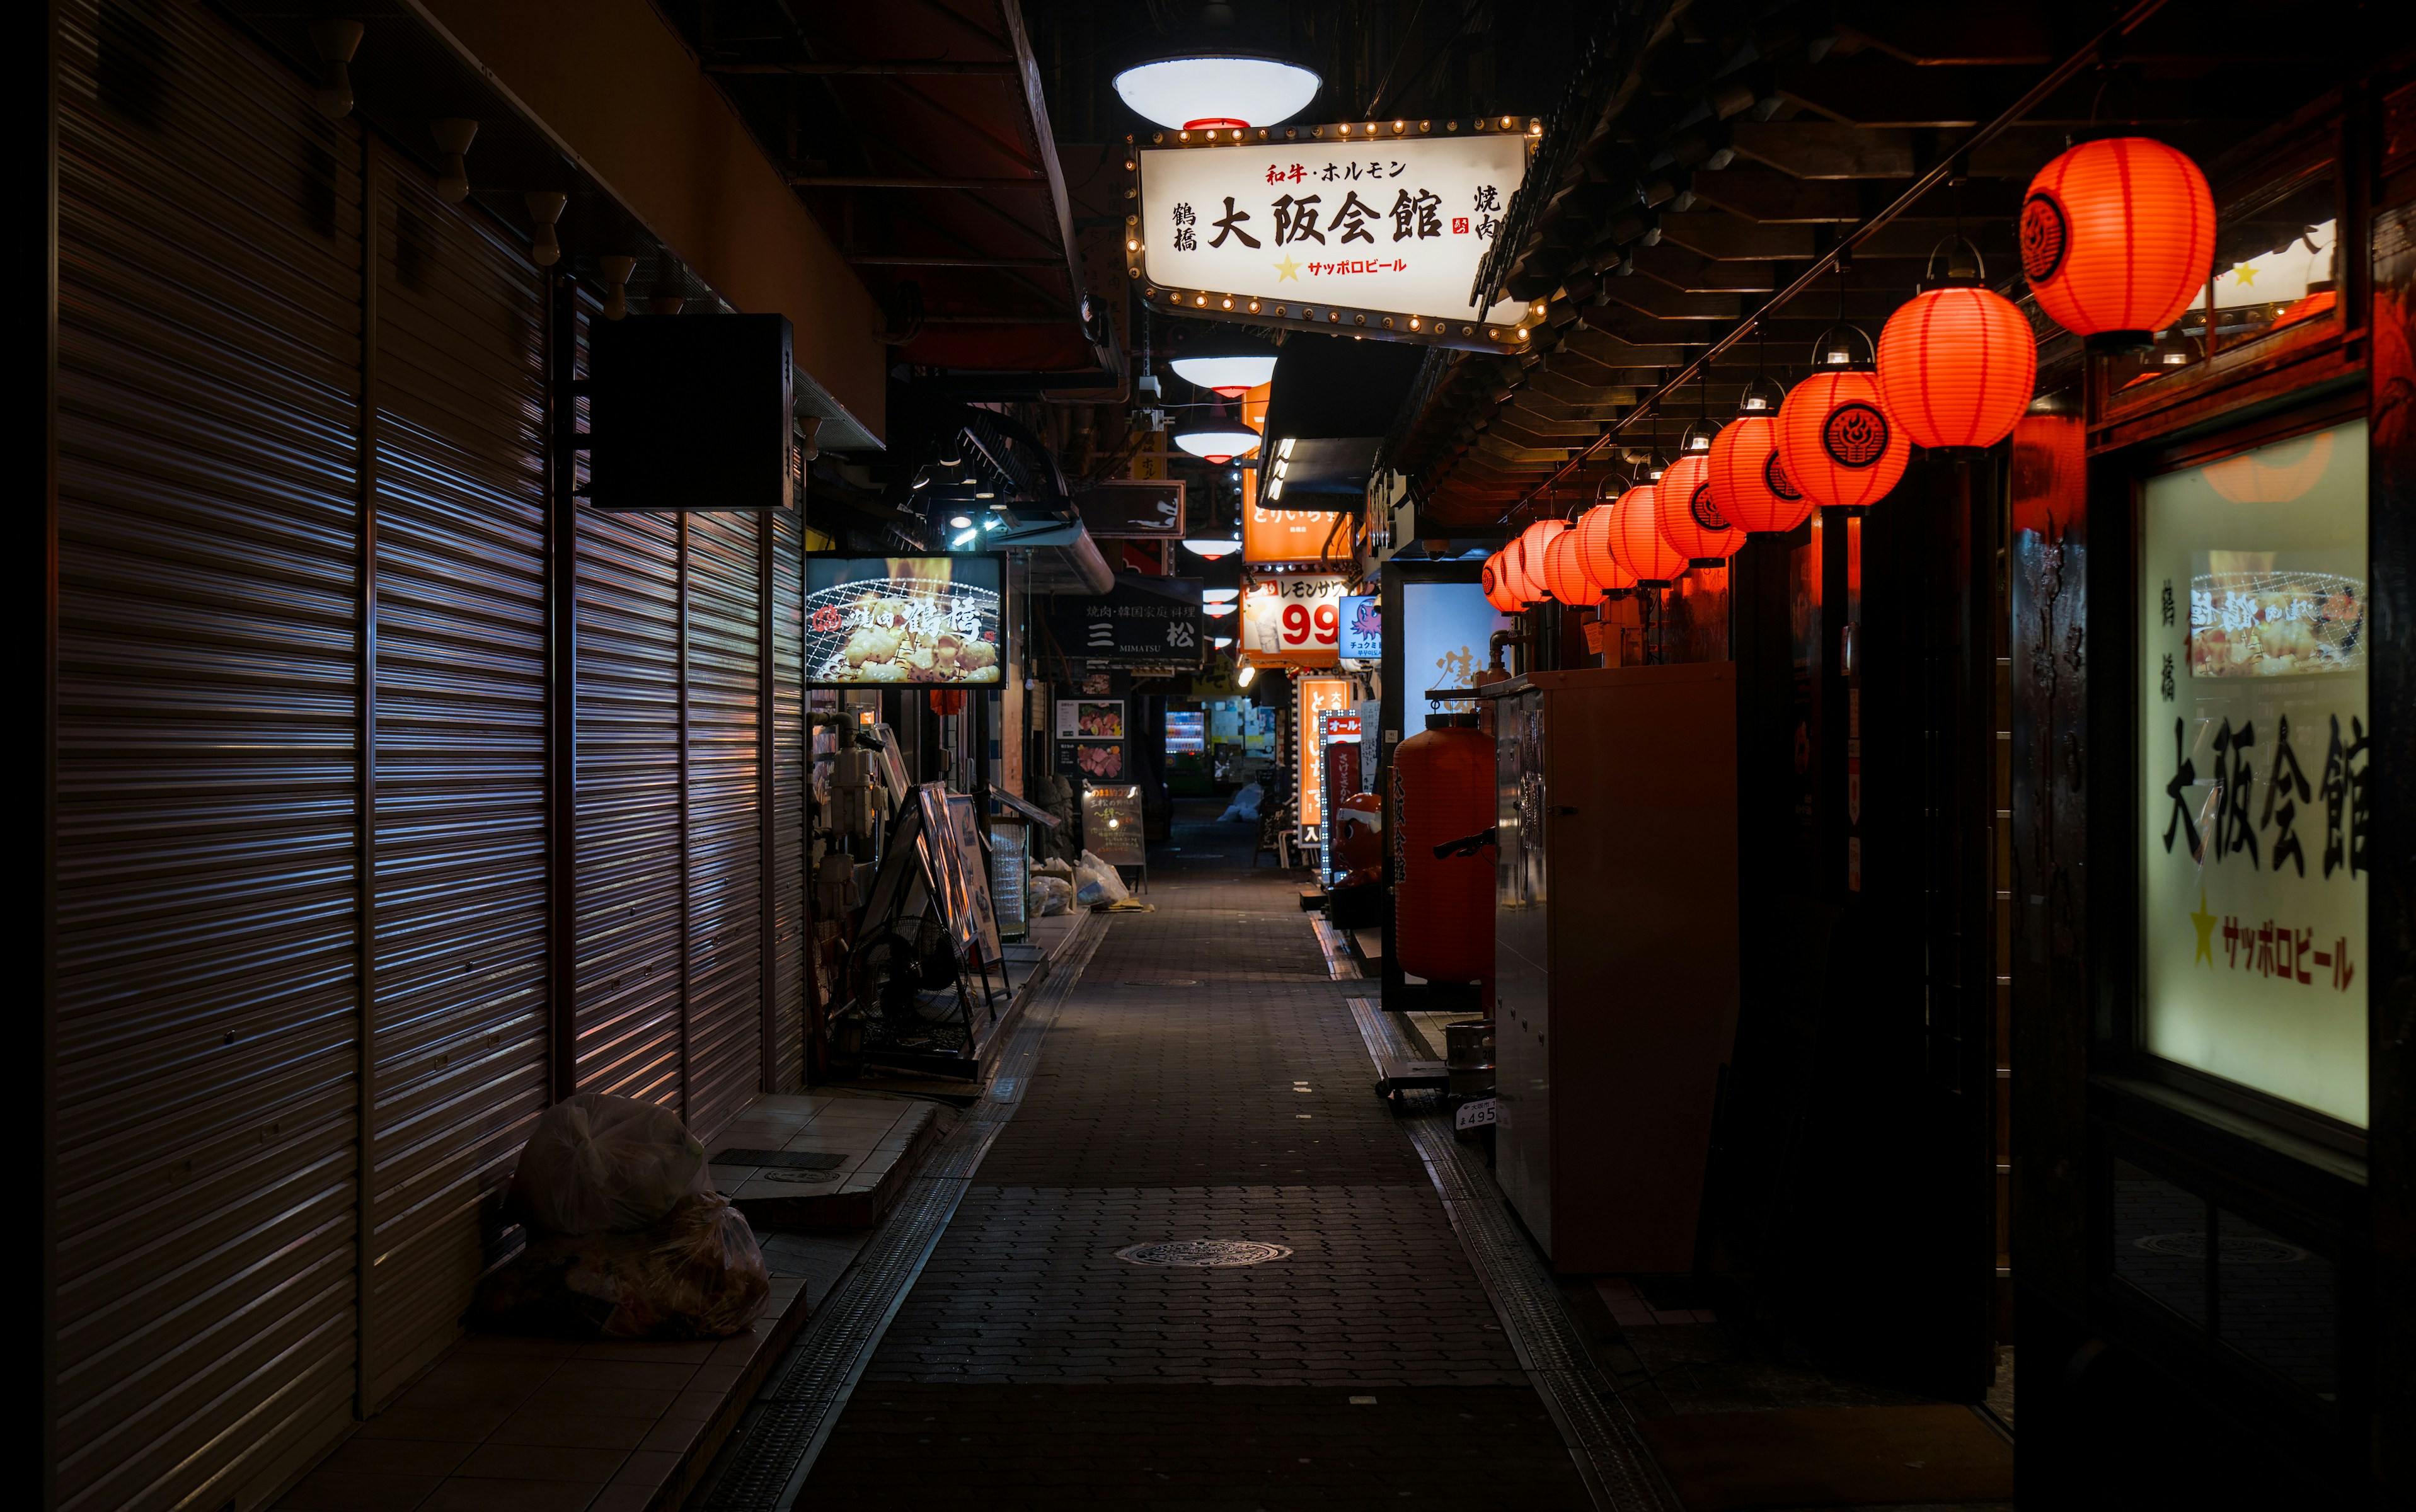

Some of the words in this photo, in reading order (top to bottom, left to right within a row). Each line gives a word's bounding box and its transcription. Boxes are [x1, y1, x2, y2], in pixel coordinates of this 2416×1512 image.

[1108, 182, 1123, 289] 韓国理・焼肉
[1173, 202, 1197, 251] 鶴橋
[1208, 188, 1442, 249] 大阪会館
[1473, 185, 1502, 240] 焼肉
[1308, 258, 1407, 277] サッポロビール
[1142, 458, 1156, 480] ホル
[1329, 720, 1361, 732] オール
[2163, 713, 2370, 880] 大阪会館
[1304, 826, 1321, 842] 入
[1393, 768, 1406, 883] 大阪会館
[2222, 915, 2356, 994] サッポロビール
